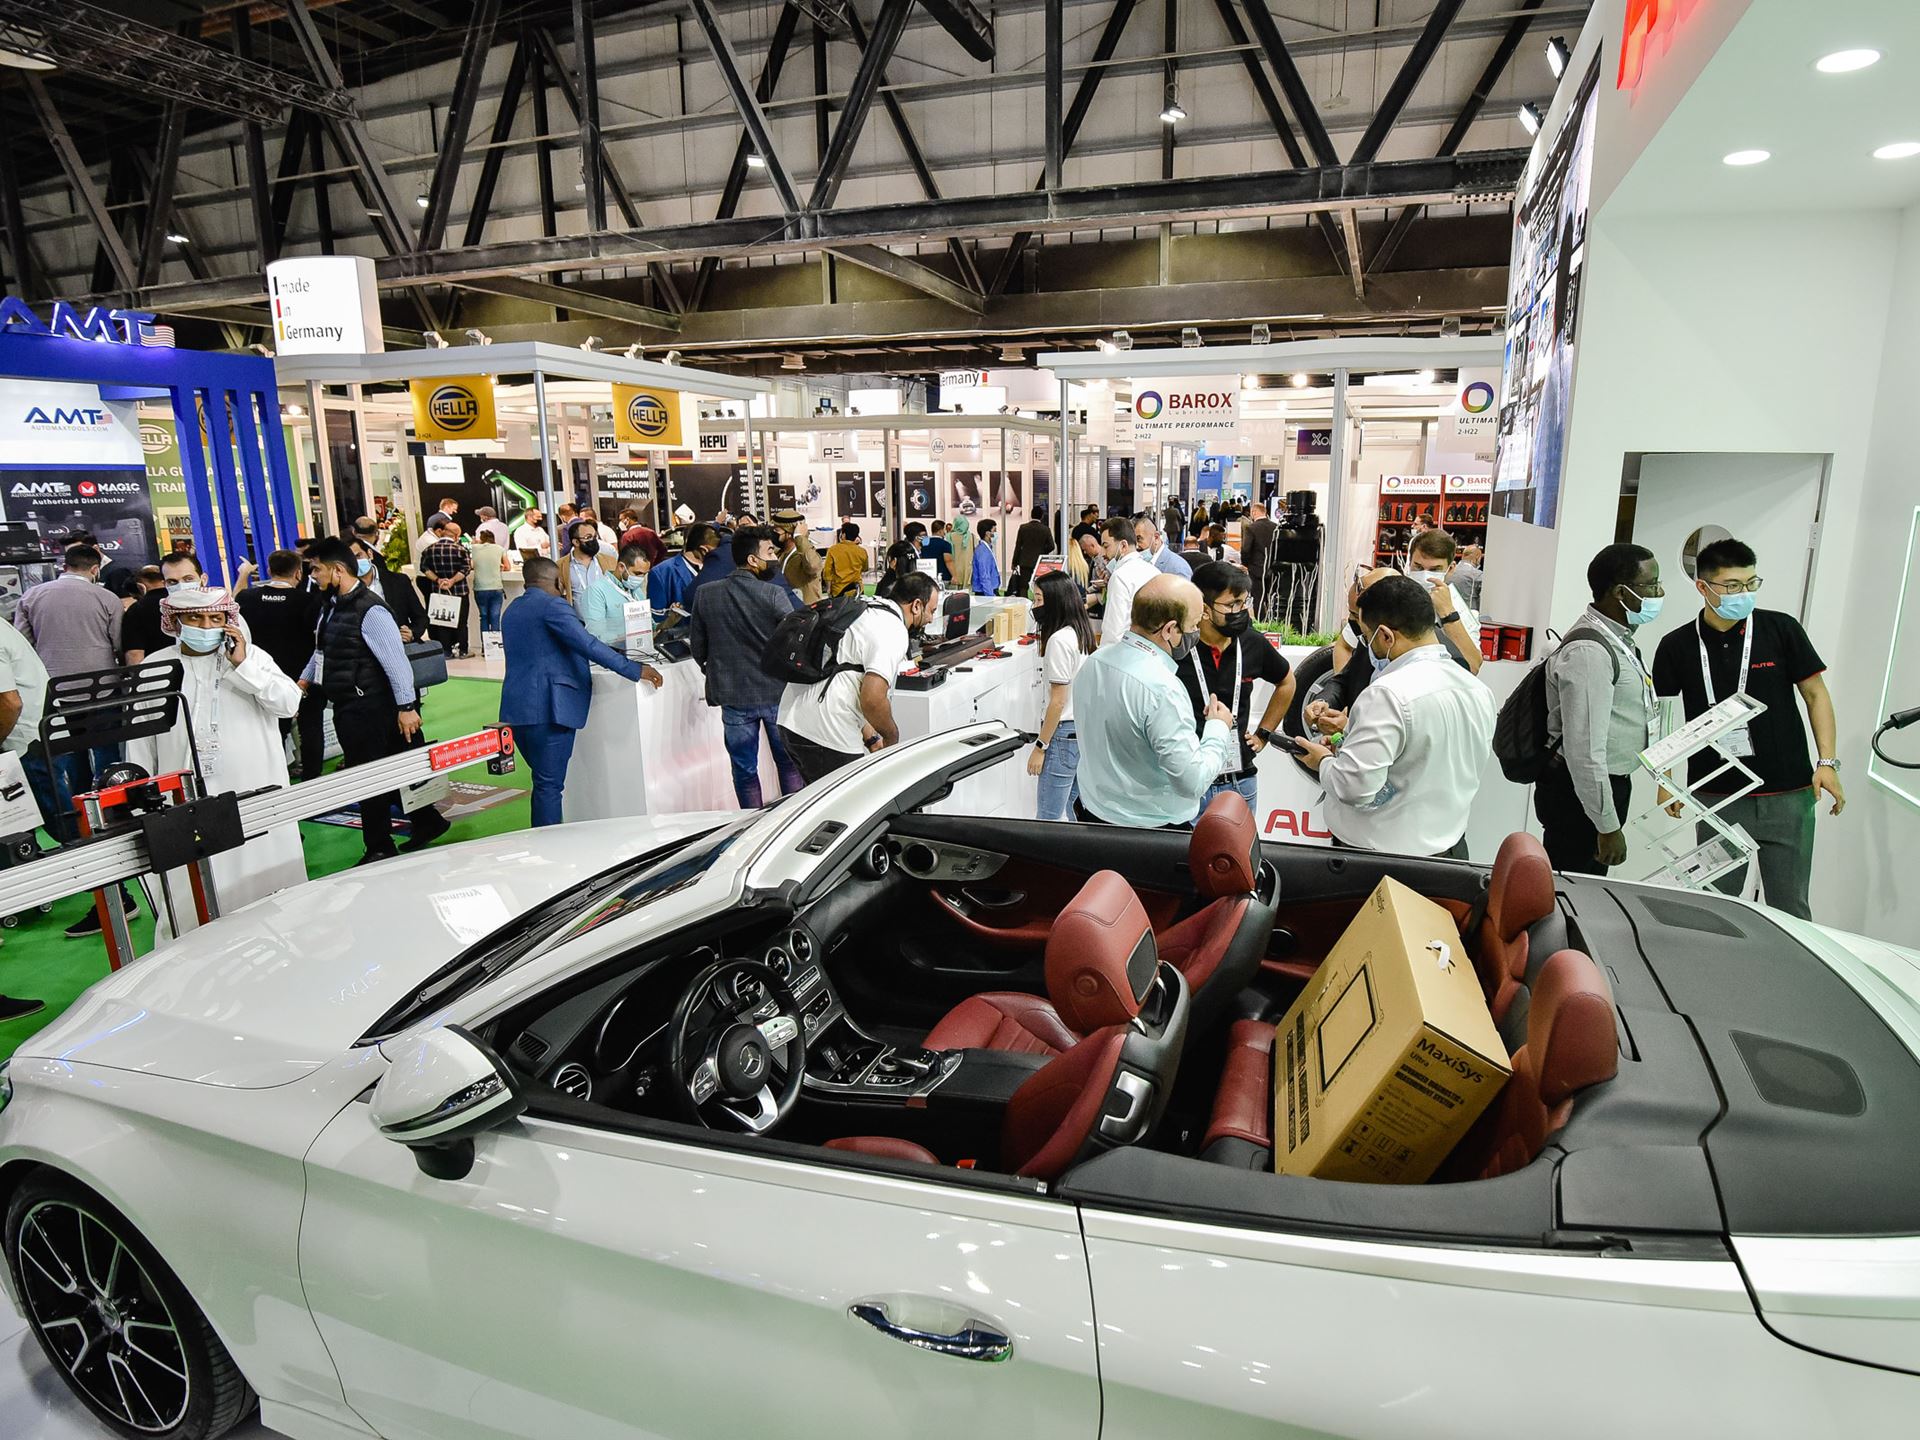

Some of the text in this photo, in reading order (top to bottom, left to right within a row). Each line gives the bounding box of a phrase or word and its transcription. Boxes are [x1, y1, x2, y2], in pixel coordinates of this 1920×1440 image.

[0, 295, 157, 346] AMT
[286, 324, 343, 342] Germany
[433, 400, 478, 416] HELLA
[1169, 392, 1233, 409] BAROX
[23, 406, 102, 426] AMT
[632, 408, 669, 425] HELLA
[31, 424, 109, 433] AUTOMAXTOOLS.COM
[1134, 421, 1236, 430] ULTIMATE PERFORMANCE
[593, 436, 618, 450] HEPU
[699, 435, 728, 449] HEPU
[10, 482, 65, 494] AMT
[97, 482, 140, 493] MAGIC
[32, 497, 125, 506] Authorized Distributor
[1751, 661, 1776, 669] AUTEL
[1409, 1051, 1430, 1068] Ultra
[1415, 1038, 1484, 1084] MaxiSys
